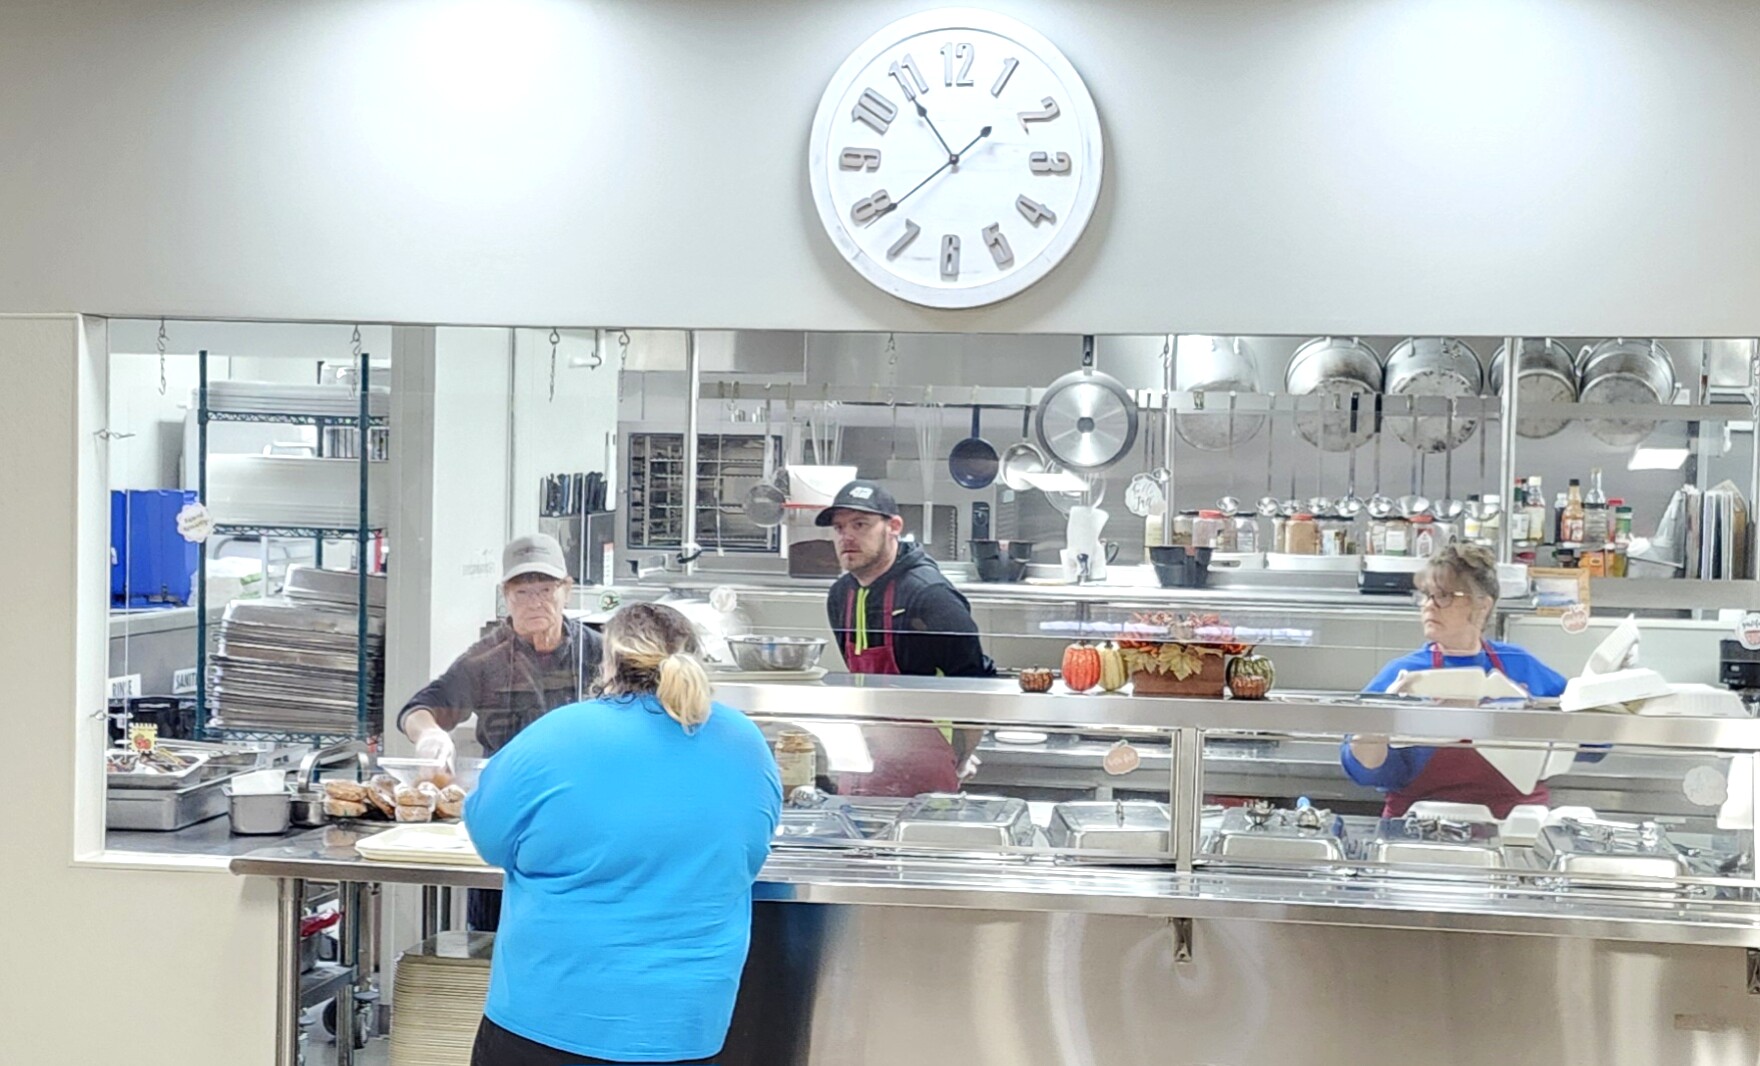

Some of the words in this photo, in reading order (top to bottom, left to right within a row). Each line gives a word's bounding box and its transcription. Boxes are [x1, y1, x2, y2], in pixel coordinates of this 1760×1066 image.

[888, 53, 929, 102] 11
[940, 42, 975, 87] 12
[991, 57, 1019, 98] 1
[851, 87, 898, 135] 10
[1017, 96, 1061, 135] 2
[839, 146, 881, 172] 9
[1029, 151, 1072, 176] 3
[850, 189, 892, 227] 8
[1015, 193, 1056, 228] 4
[886, 218, 921, 261] 7
[940, 234, 961, 281] 6
[981, 222, 1014, 270] 5
[112, 679, 132, 698] RINE
[176, 672, 197, 690] SANIT
